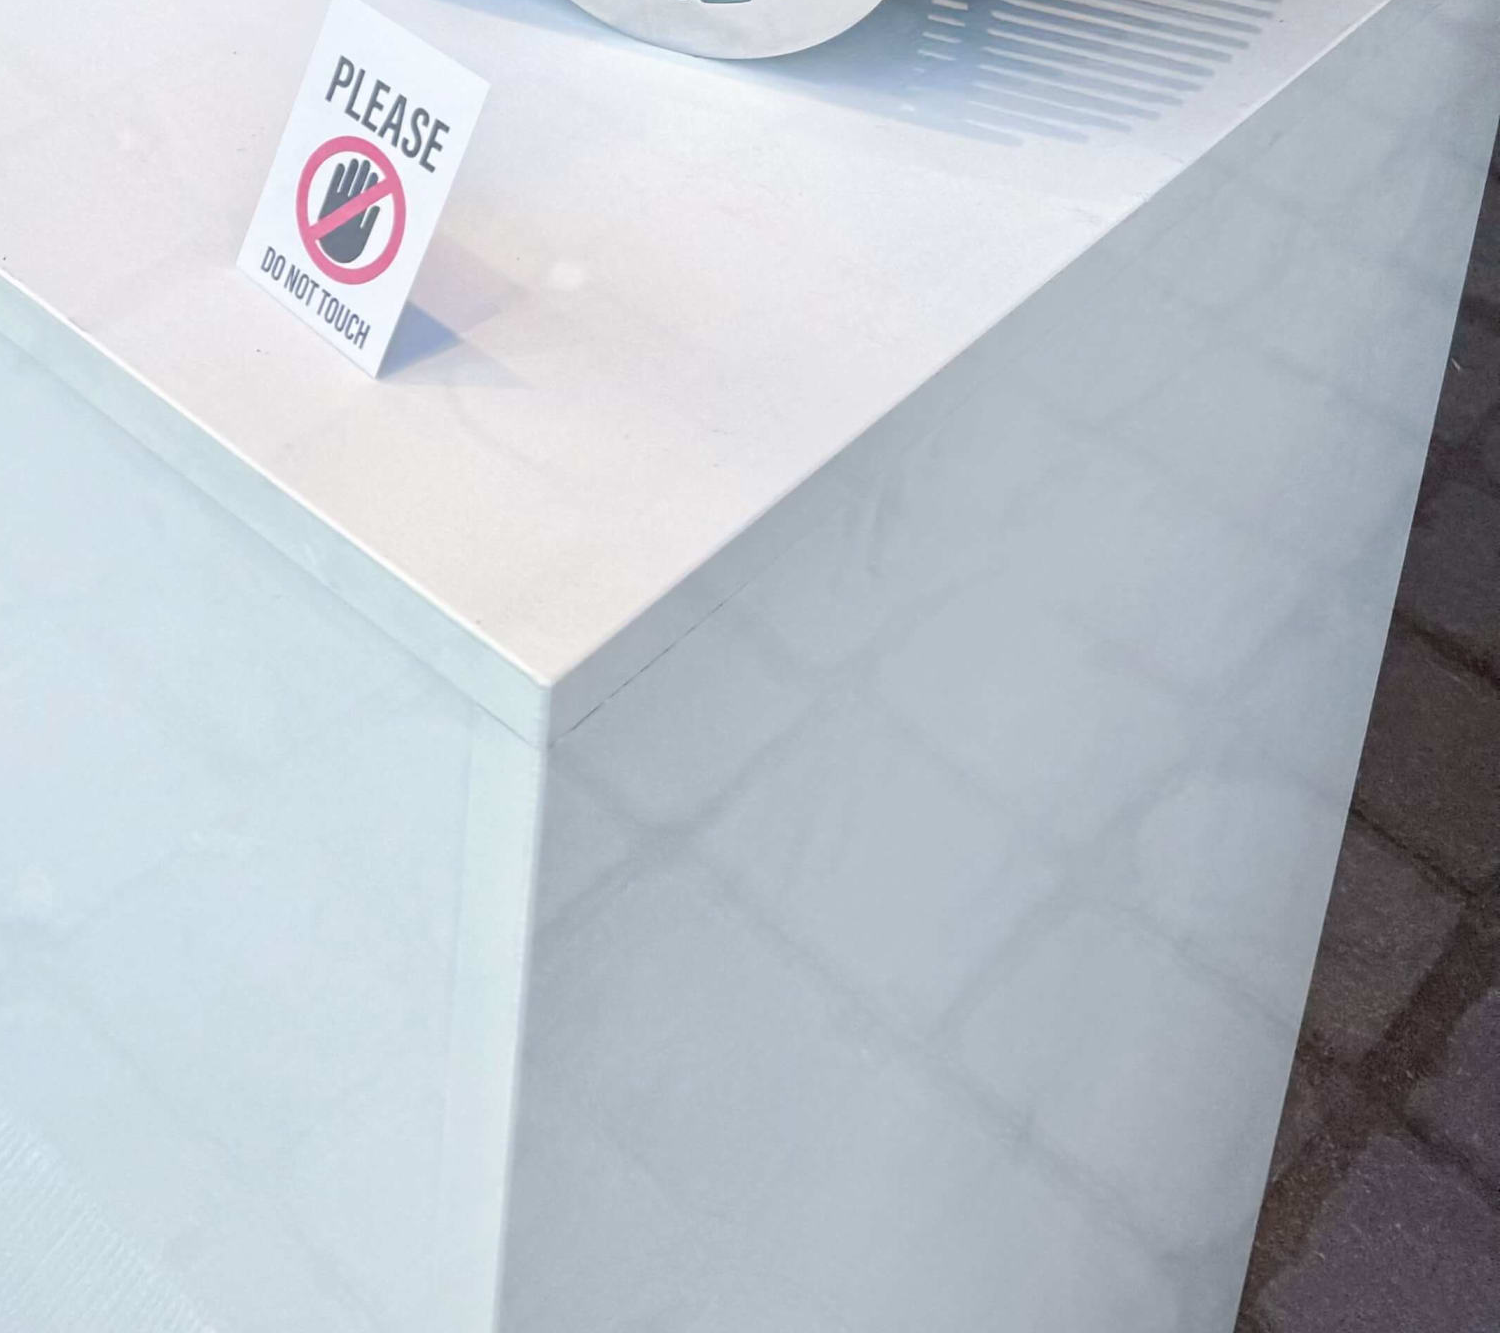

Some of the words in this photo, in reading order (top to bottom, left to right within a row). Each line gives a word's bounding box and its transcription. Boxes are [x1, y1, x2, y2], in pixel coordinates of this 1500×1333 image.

[324, 55, 450, 173] PLEASE
[260, 245, 285, 281] DO
[284, 263, 320, 308] NOT
[313, 287, 371, 350] TOUCH
